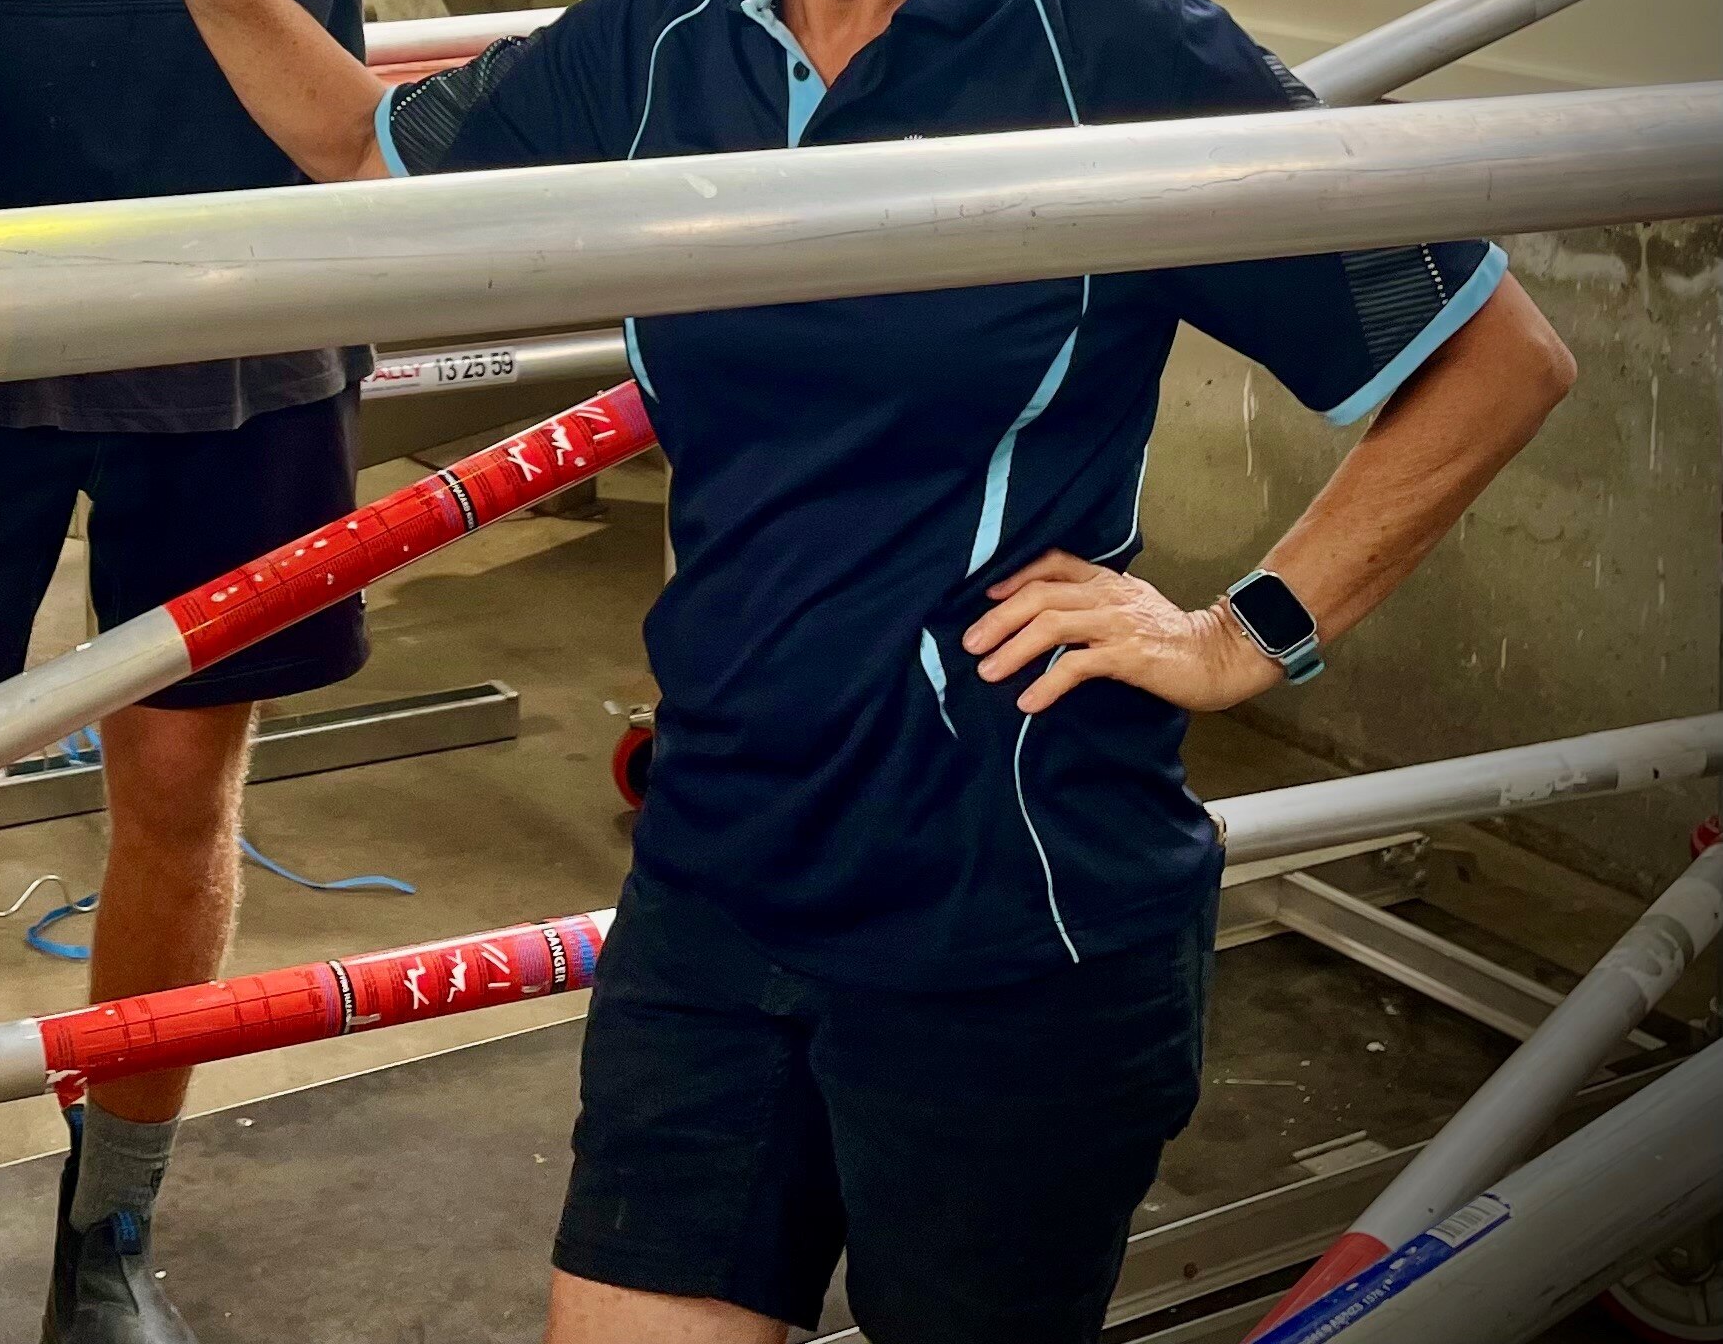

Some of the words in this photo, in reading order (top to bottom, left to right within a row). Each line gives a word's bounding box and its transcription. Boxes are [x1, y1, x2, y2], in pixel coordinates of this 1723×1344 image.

[435, 358, 458, 381] 13
[461, 354, 486, 379] 25
[491, 351, 514, 376] 59
[543, 928, 566, 984] DANGER
